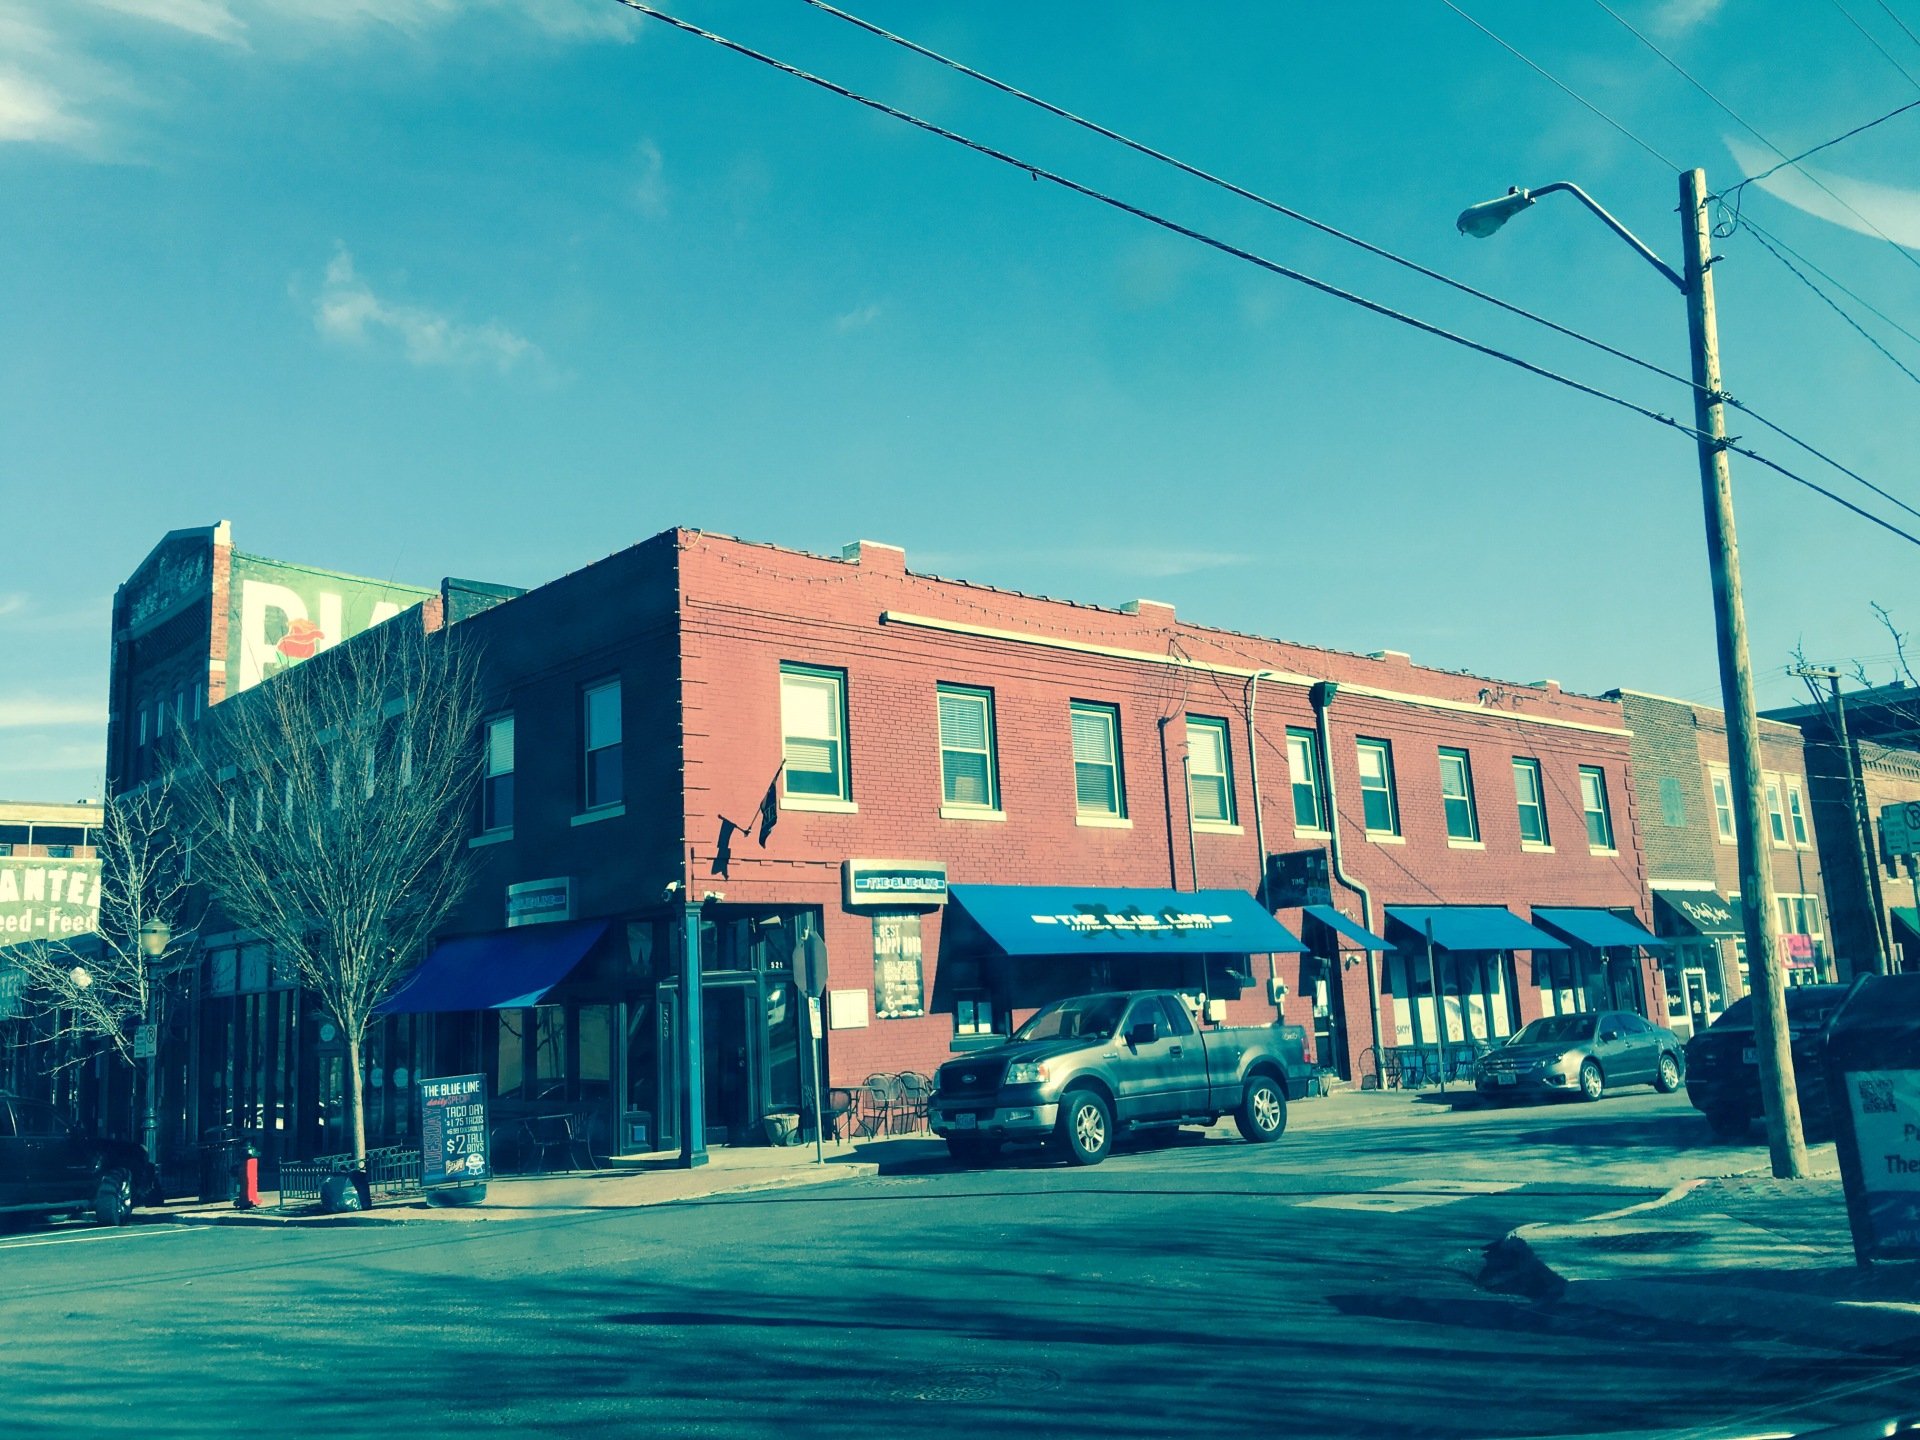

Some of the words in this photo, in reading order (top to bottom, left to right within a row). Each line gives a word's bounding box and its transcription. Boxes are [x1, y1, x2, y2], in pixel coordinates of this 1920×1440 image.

[879, 924, 900, 937] BEST
[1396, 1025, 1411, 1035] SKYY
[424, 1085, 439, 1098] THE
[441, 1083, 461, 1096] BLUE
[463, 1080, 480, 1094] LINE
[446, 1106, 467, 1118] TACO
[468, 1104, 484, 1116] DAY
[465, 1115, 484, 1125] TACOS
[423, 1108, 443, 1173] TUESDAY
[466, 1133, 484, 1144] TALL
[466, 1142, 485, 1154] BOYS
